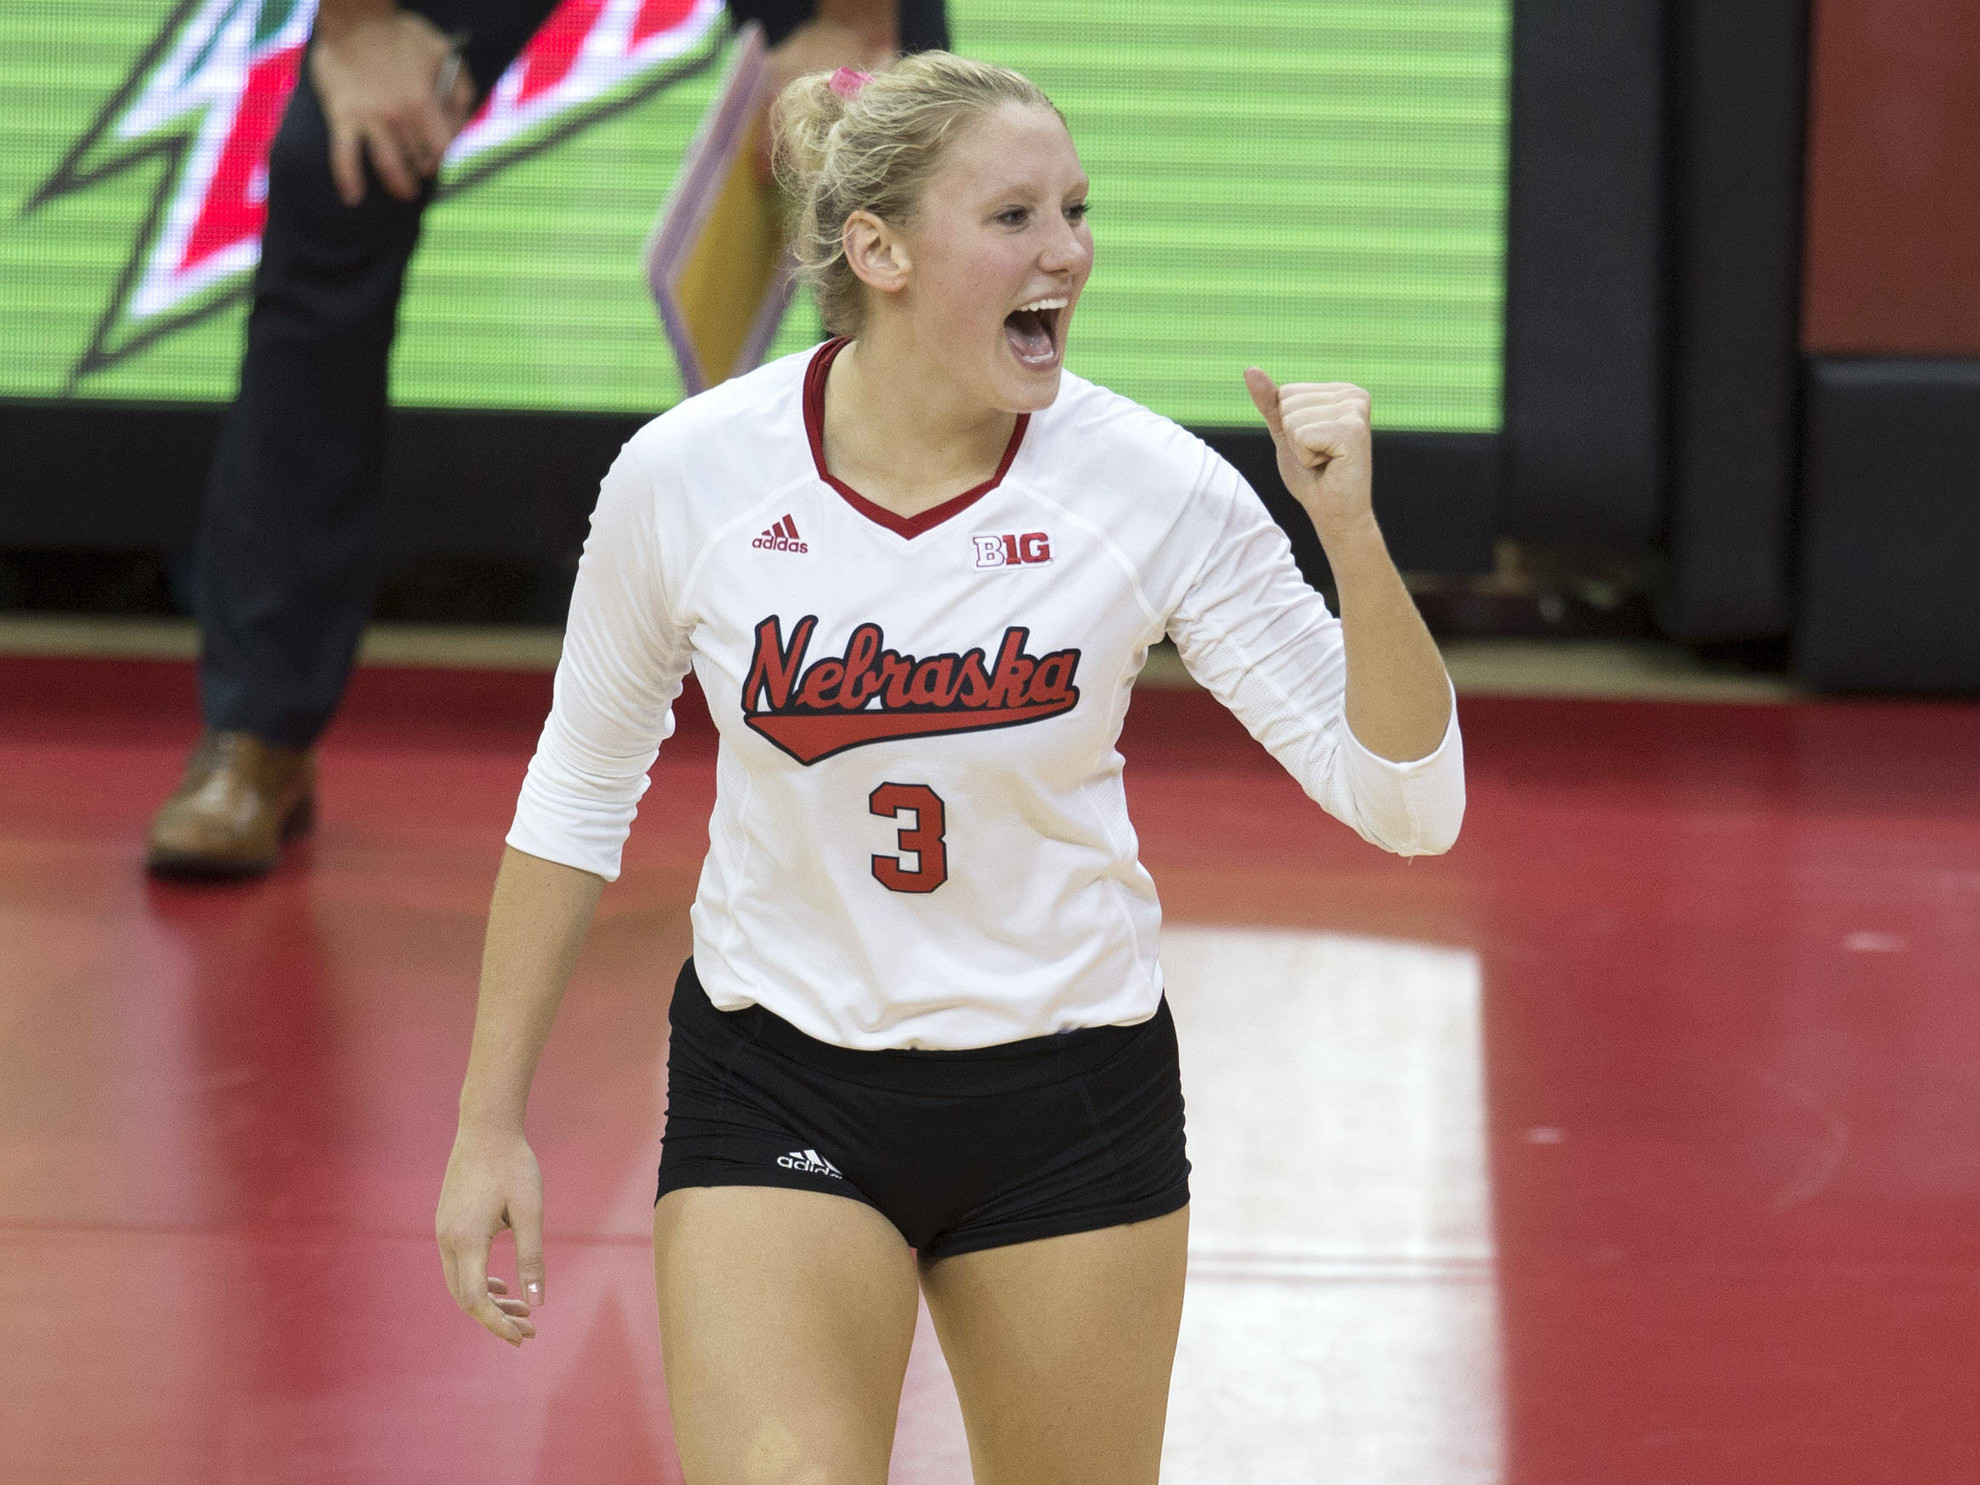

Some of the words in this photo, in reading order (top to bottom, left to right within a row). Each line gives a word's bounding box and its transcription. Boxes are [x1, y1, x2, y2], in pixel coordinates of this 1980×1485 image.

[752, 536, 808, 554] adidas
[741, 614, 1082, 716] Nebraska
[869, 781, 948, 893] 3
